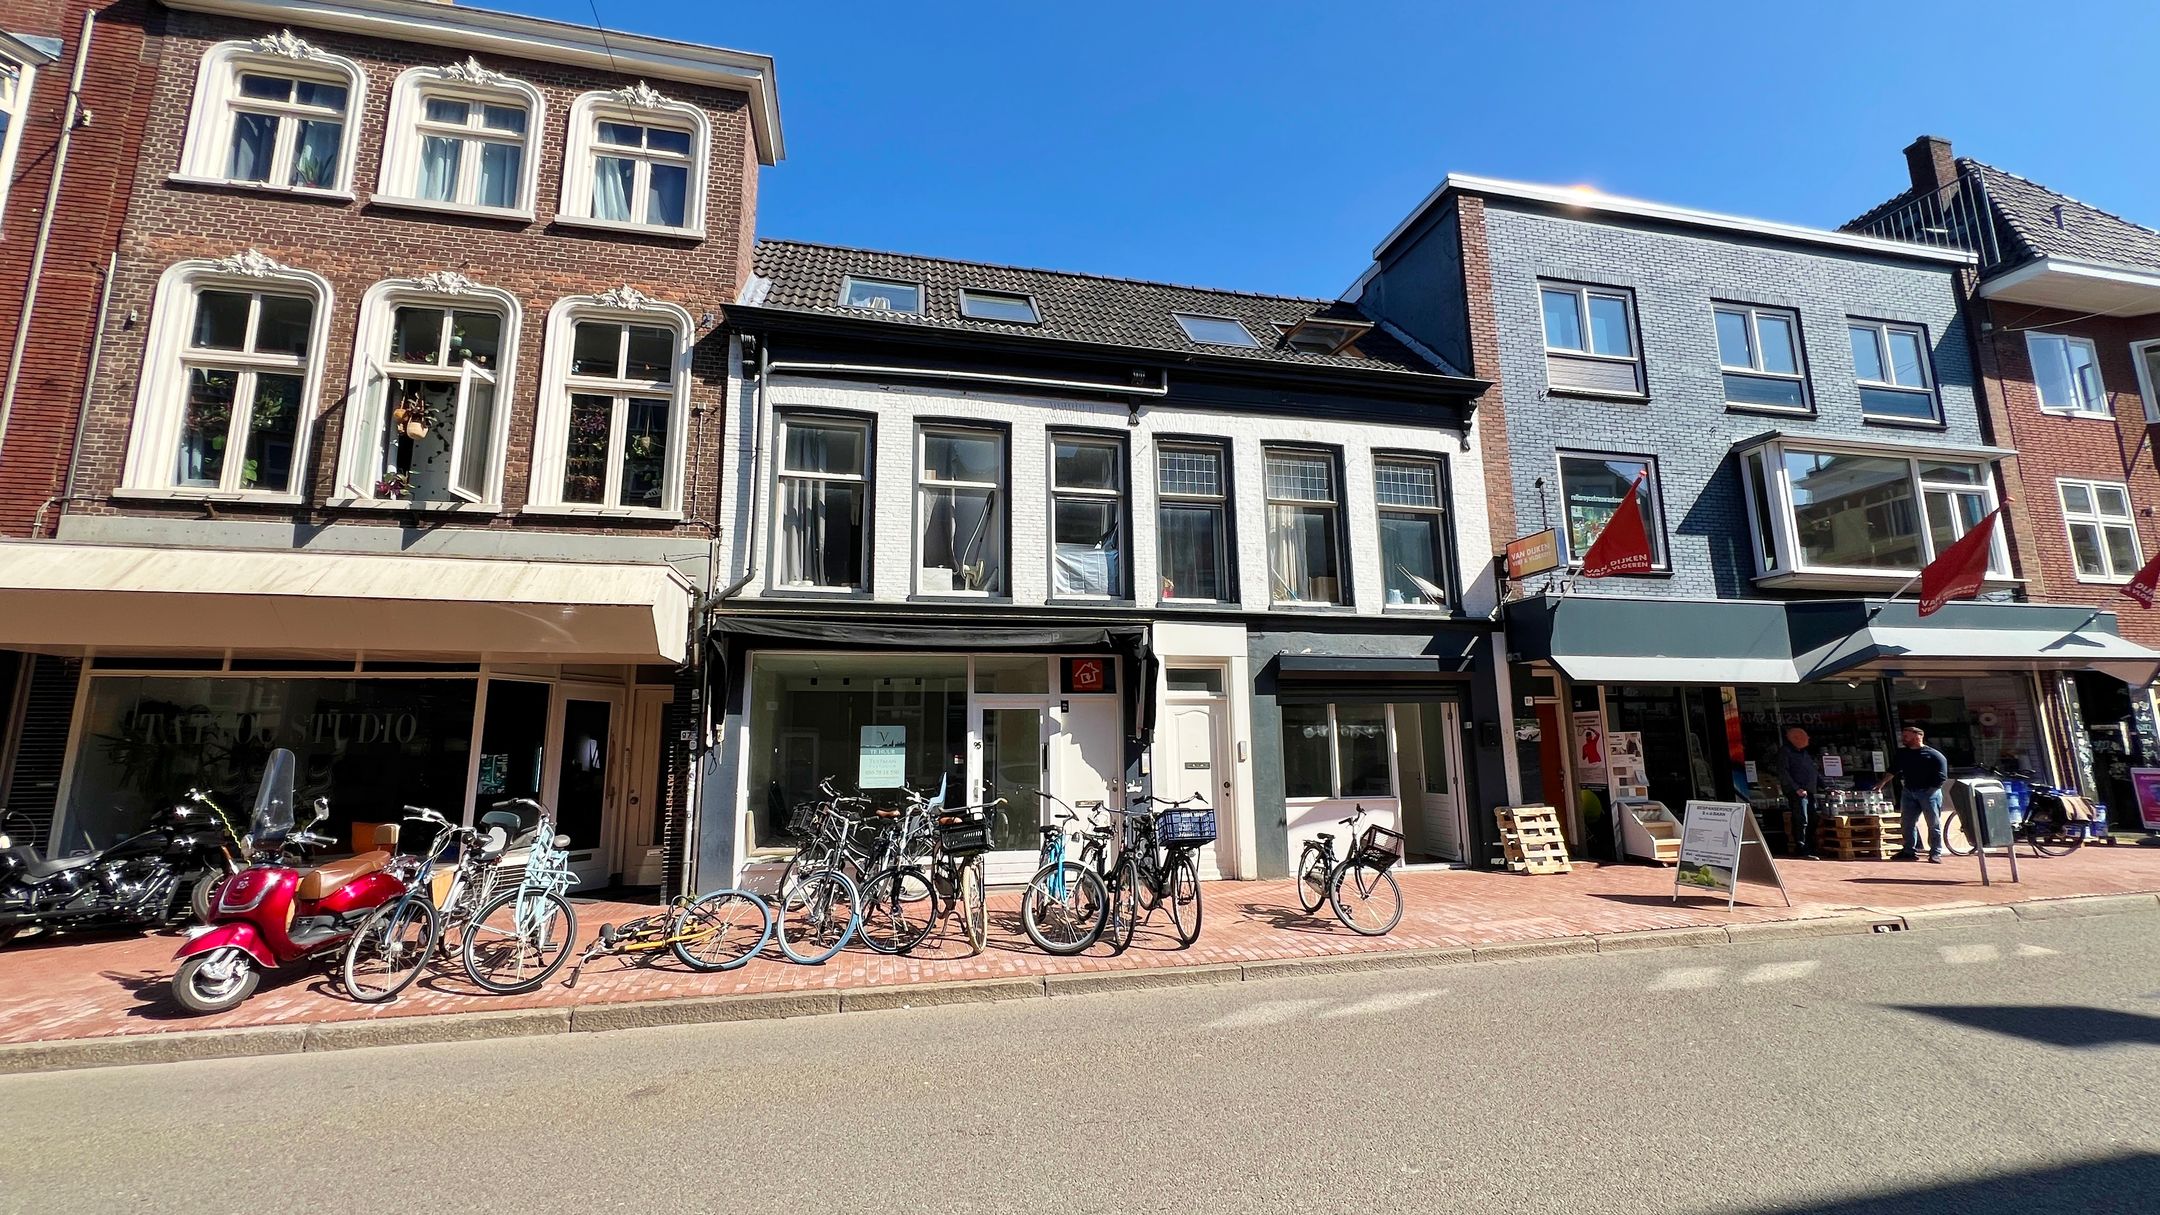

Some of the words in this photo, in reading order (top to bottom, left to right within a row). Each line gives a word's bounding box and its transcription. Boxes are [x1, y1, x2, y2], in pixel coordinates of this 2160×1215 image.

[1511, 551, 1525, 560] VAN
[1526, 543, 1550, 556] DIJKEN
[1586, 564, 1607, 573] VAN
[1610, 554, 1647, 566] DIJKEN
[1611, 562, 1648, 570] VLOEREN
[139, 712, 278, 745] TATTOO
[290, 712, 418, 745] STUDIO
[973, 741, 982, 750] 95
